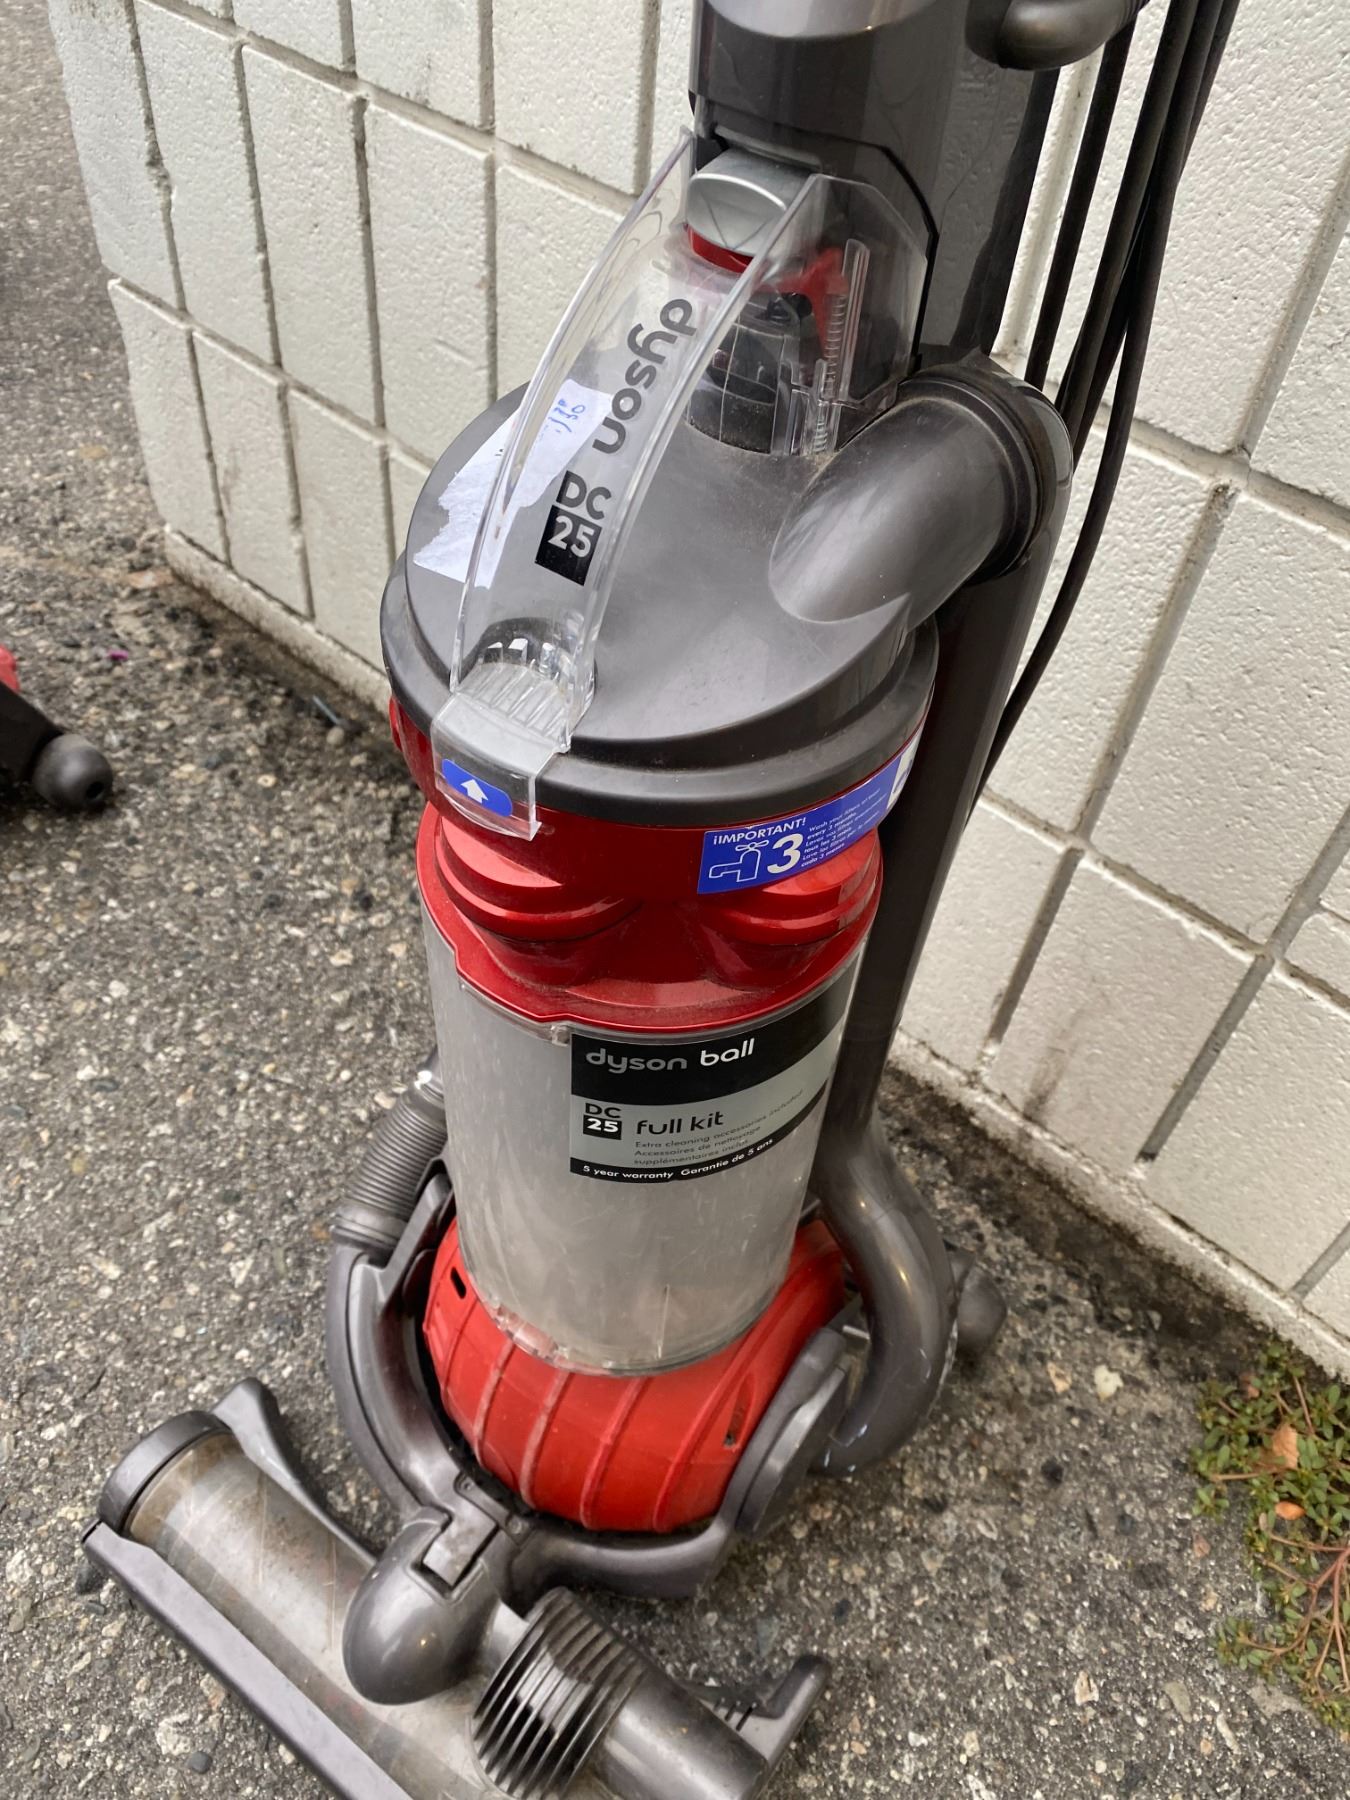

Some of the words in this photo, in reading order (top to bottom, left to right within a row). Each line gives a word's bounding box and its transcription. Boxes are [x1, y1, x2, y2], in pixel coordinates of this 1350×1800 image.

[592, 299, 697, 454] dyson
[555, 470, 612, 520] DC
[547, 515, 595, 558] 25
[809, 821, 828, 832] Wash
[767, 833, 804, 874] 3
[585, 1048, 688, 1074] dyson
[700, 1037, 756, 1067] ball
[585, 1102, 622, 1119] DC
[586, 1118, 619, 1133] 25
[636, 1118, 683, 1135] full
[690, 1111, 724, 1132] kit
[634, 1145, 698, 1156] Accessoires
[698, 1143, 712, 1151] de
[635, 1140, 662, 1148] Extra
[665, 1136, 710, 1148] cleaning
[593, 1168, 620, 1177] year
[622, 1171, 674, 1179] warranty
[680, 1159, 729, 1176] Garantie
[731, 1153, 745, 1163] de
[747, 1147, 755, 1156] 5
[756, 1138, 774, 1151] ans
